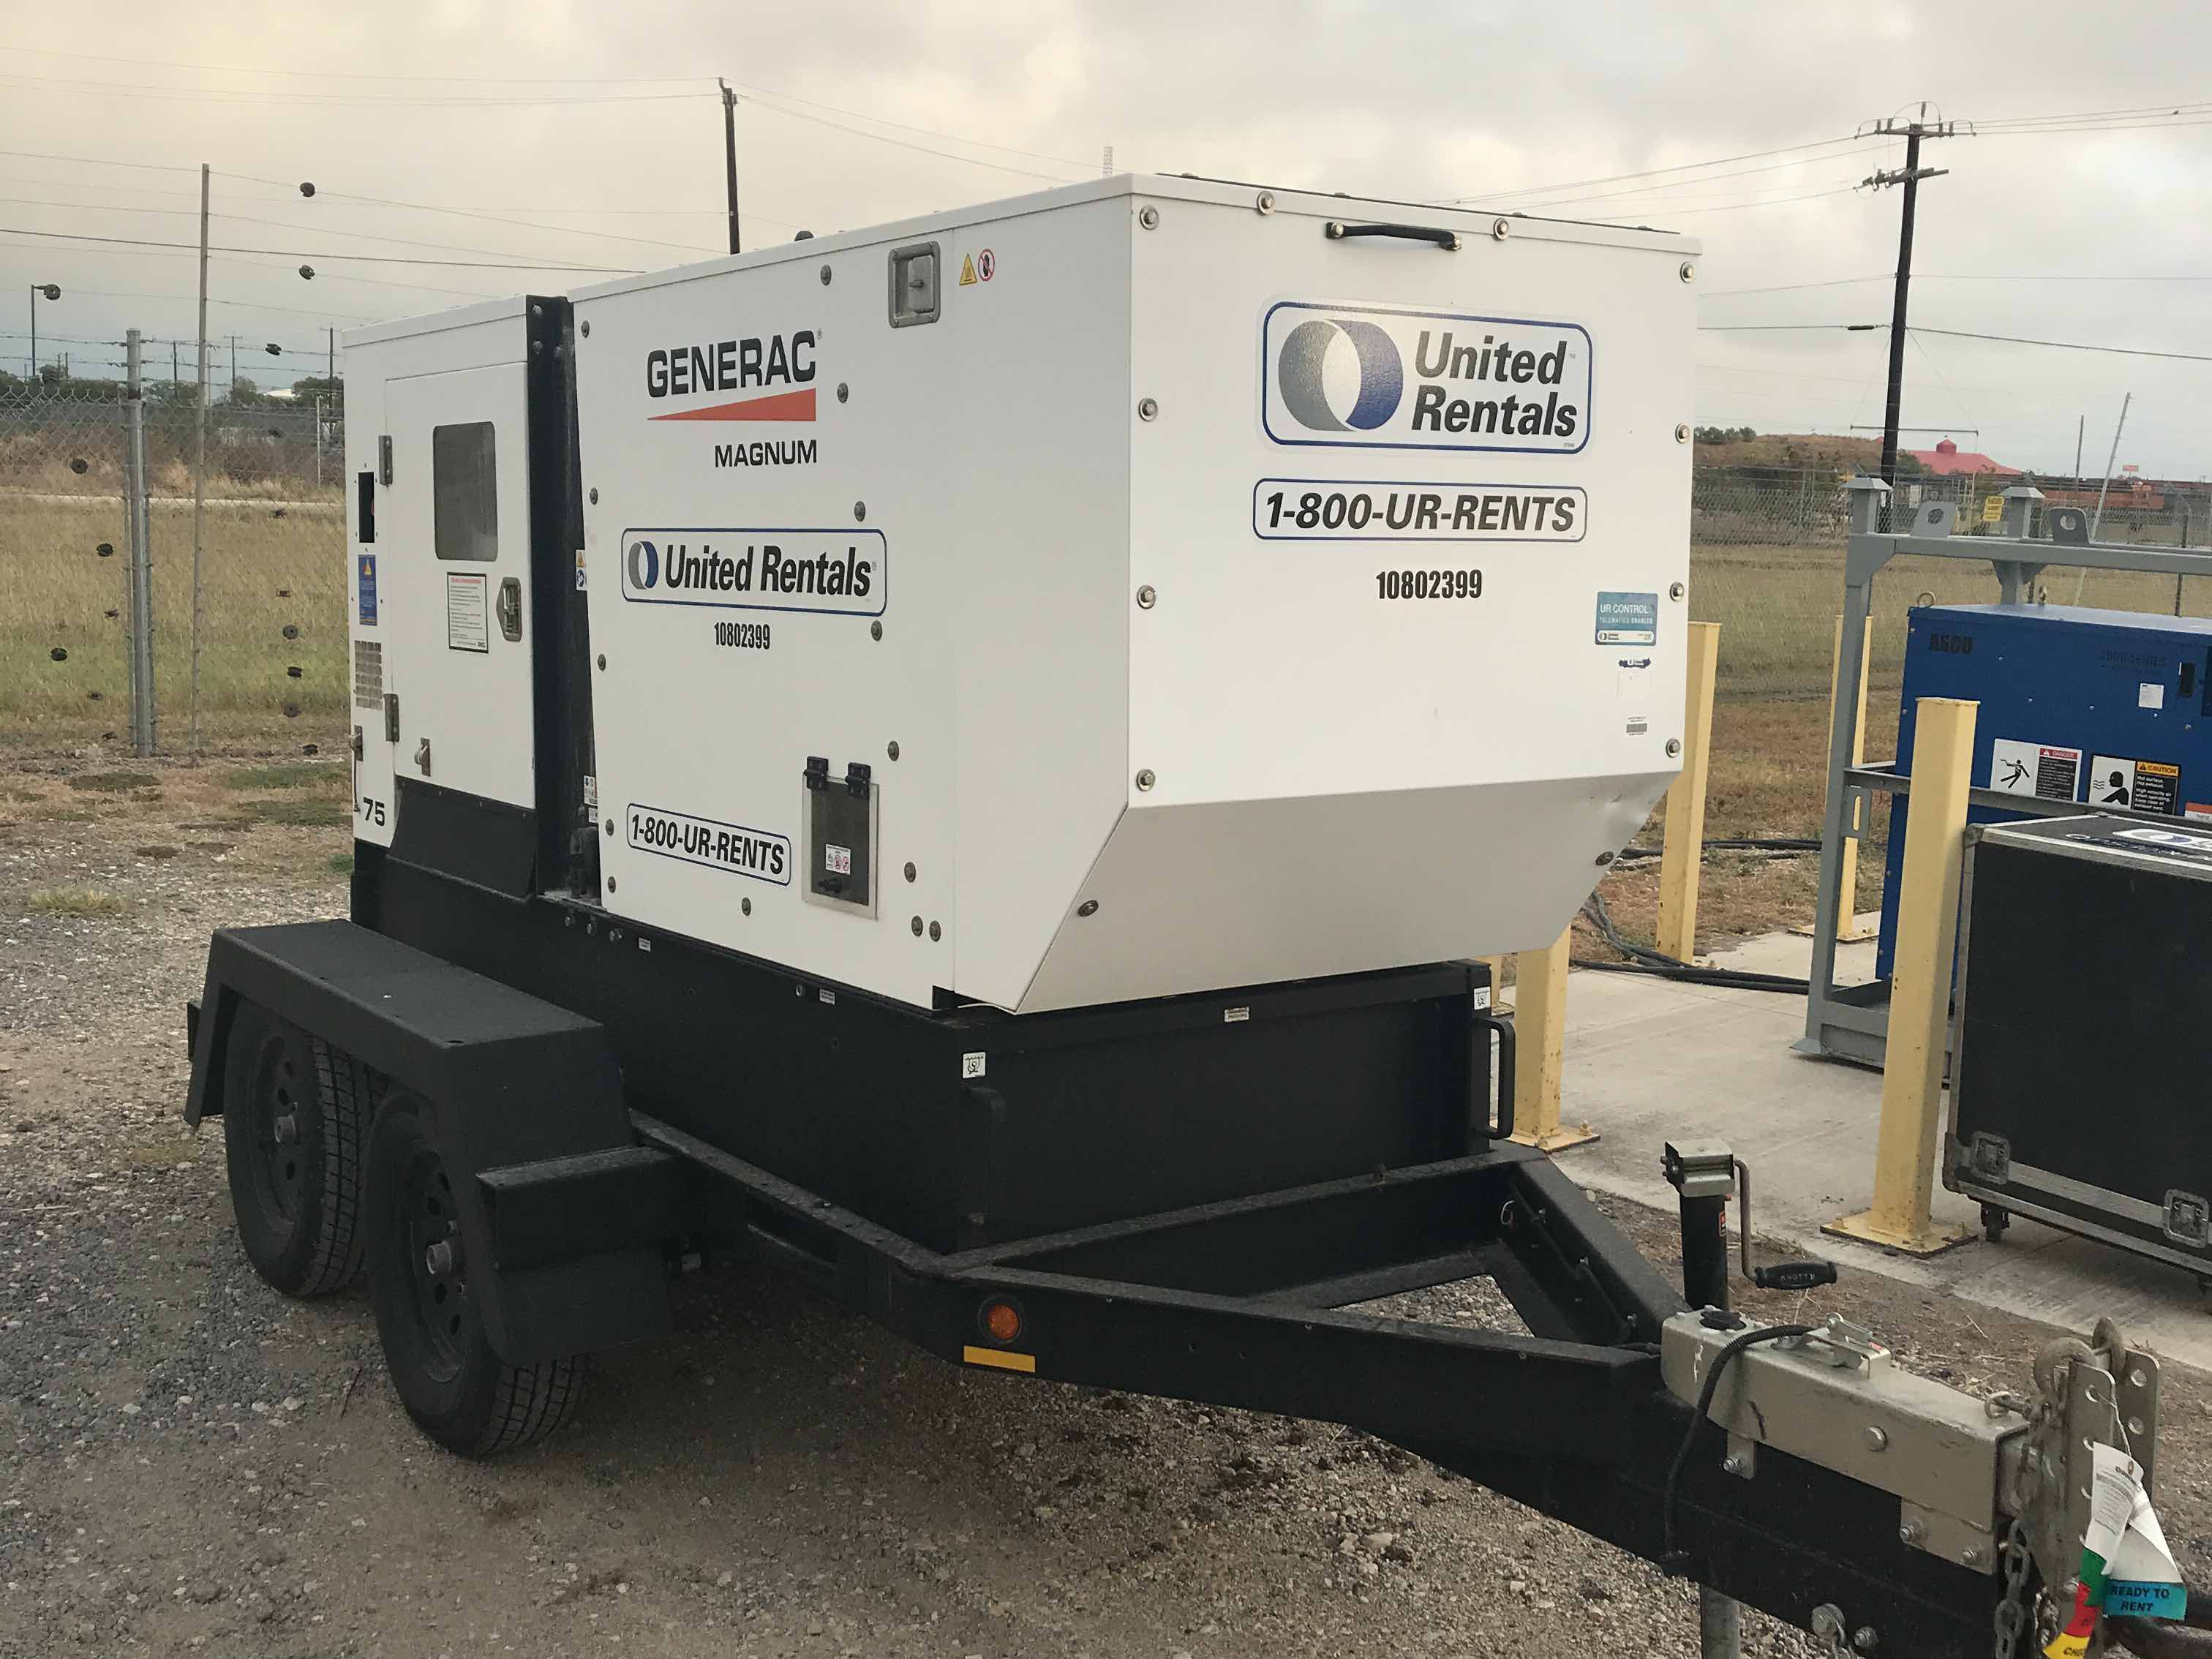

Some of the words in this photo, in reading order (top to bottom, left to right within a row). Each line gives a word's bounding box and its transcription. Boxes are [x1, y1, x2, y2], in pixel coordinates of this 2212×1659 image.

[647, 330, 816, 398] GENERAC
[1415, 331, 1568, 384] United
[1412, 385, 1577, 437] Rentals
[715, 439, 817, 468] MAGNUM
[1266, 492, 1576, 532] 1-800-UR-RENTS
[666, 544, 754, 591] United
[760, 545, 871, 597] Rentals
[1376, 569, 1482, 599] 10802399
[1600, 603, 1611, 614] UR
[1613, 603, 1649, 614] CONTROL
[714, 622, 771, 650] 10802399
[2148, 765, 2177, 774] CAUTION
[363, 797, 385, 827] 75
[632, 814, 784, 874] 1-800-UR-RENTS
[2111, 1586, 2150, 1598] READY
[2153, 1587, 2170, 1598] TO
[2121, 1601, 2153, 1612] RENT
